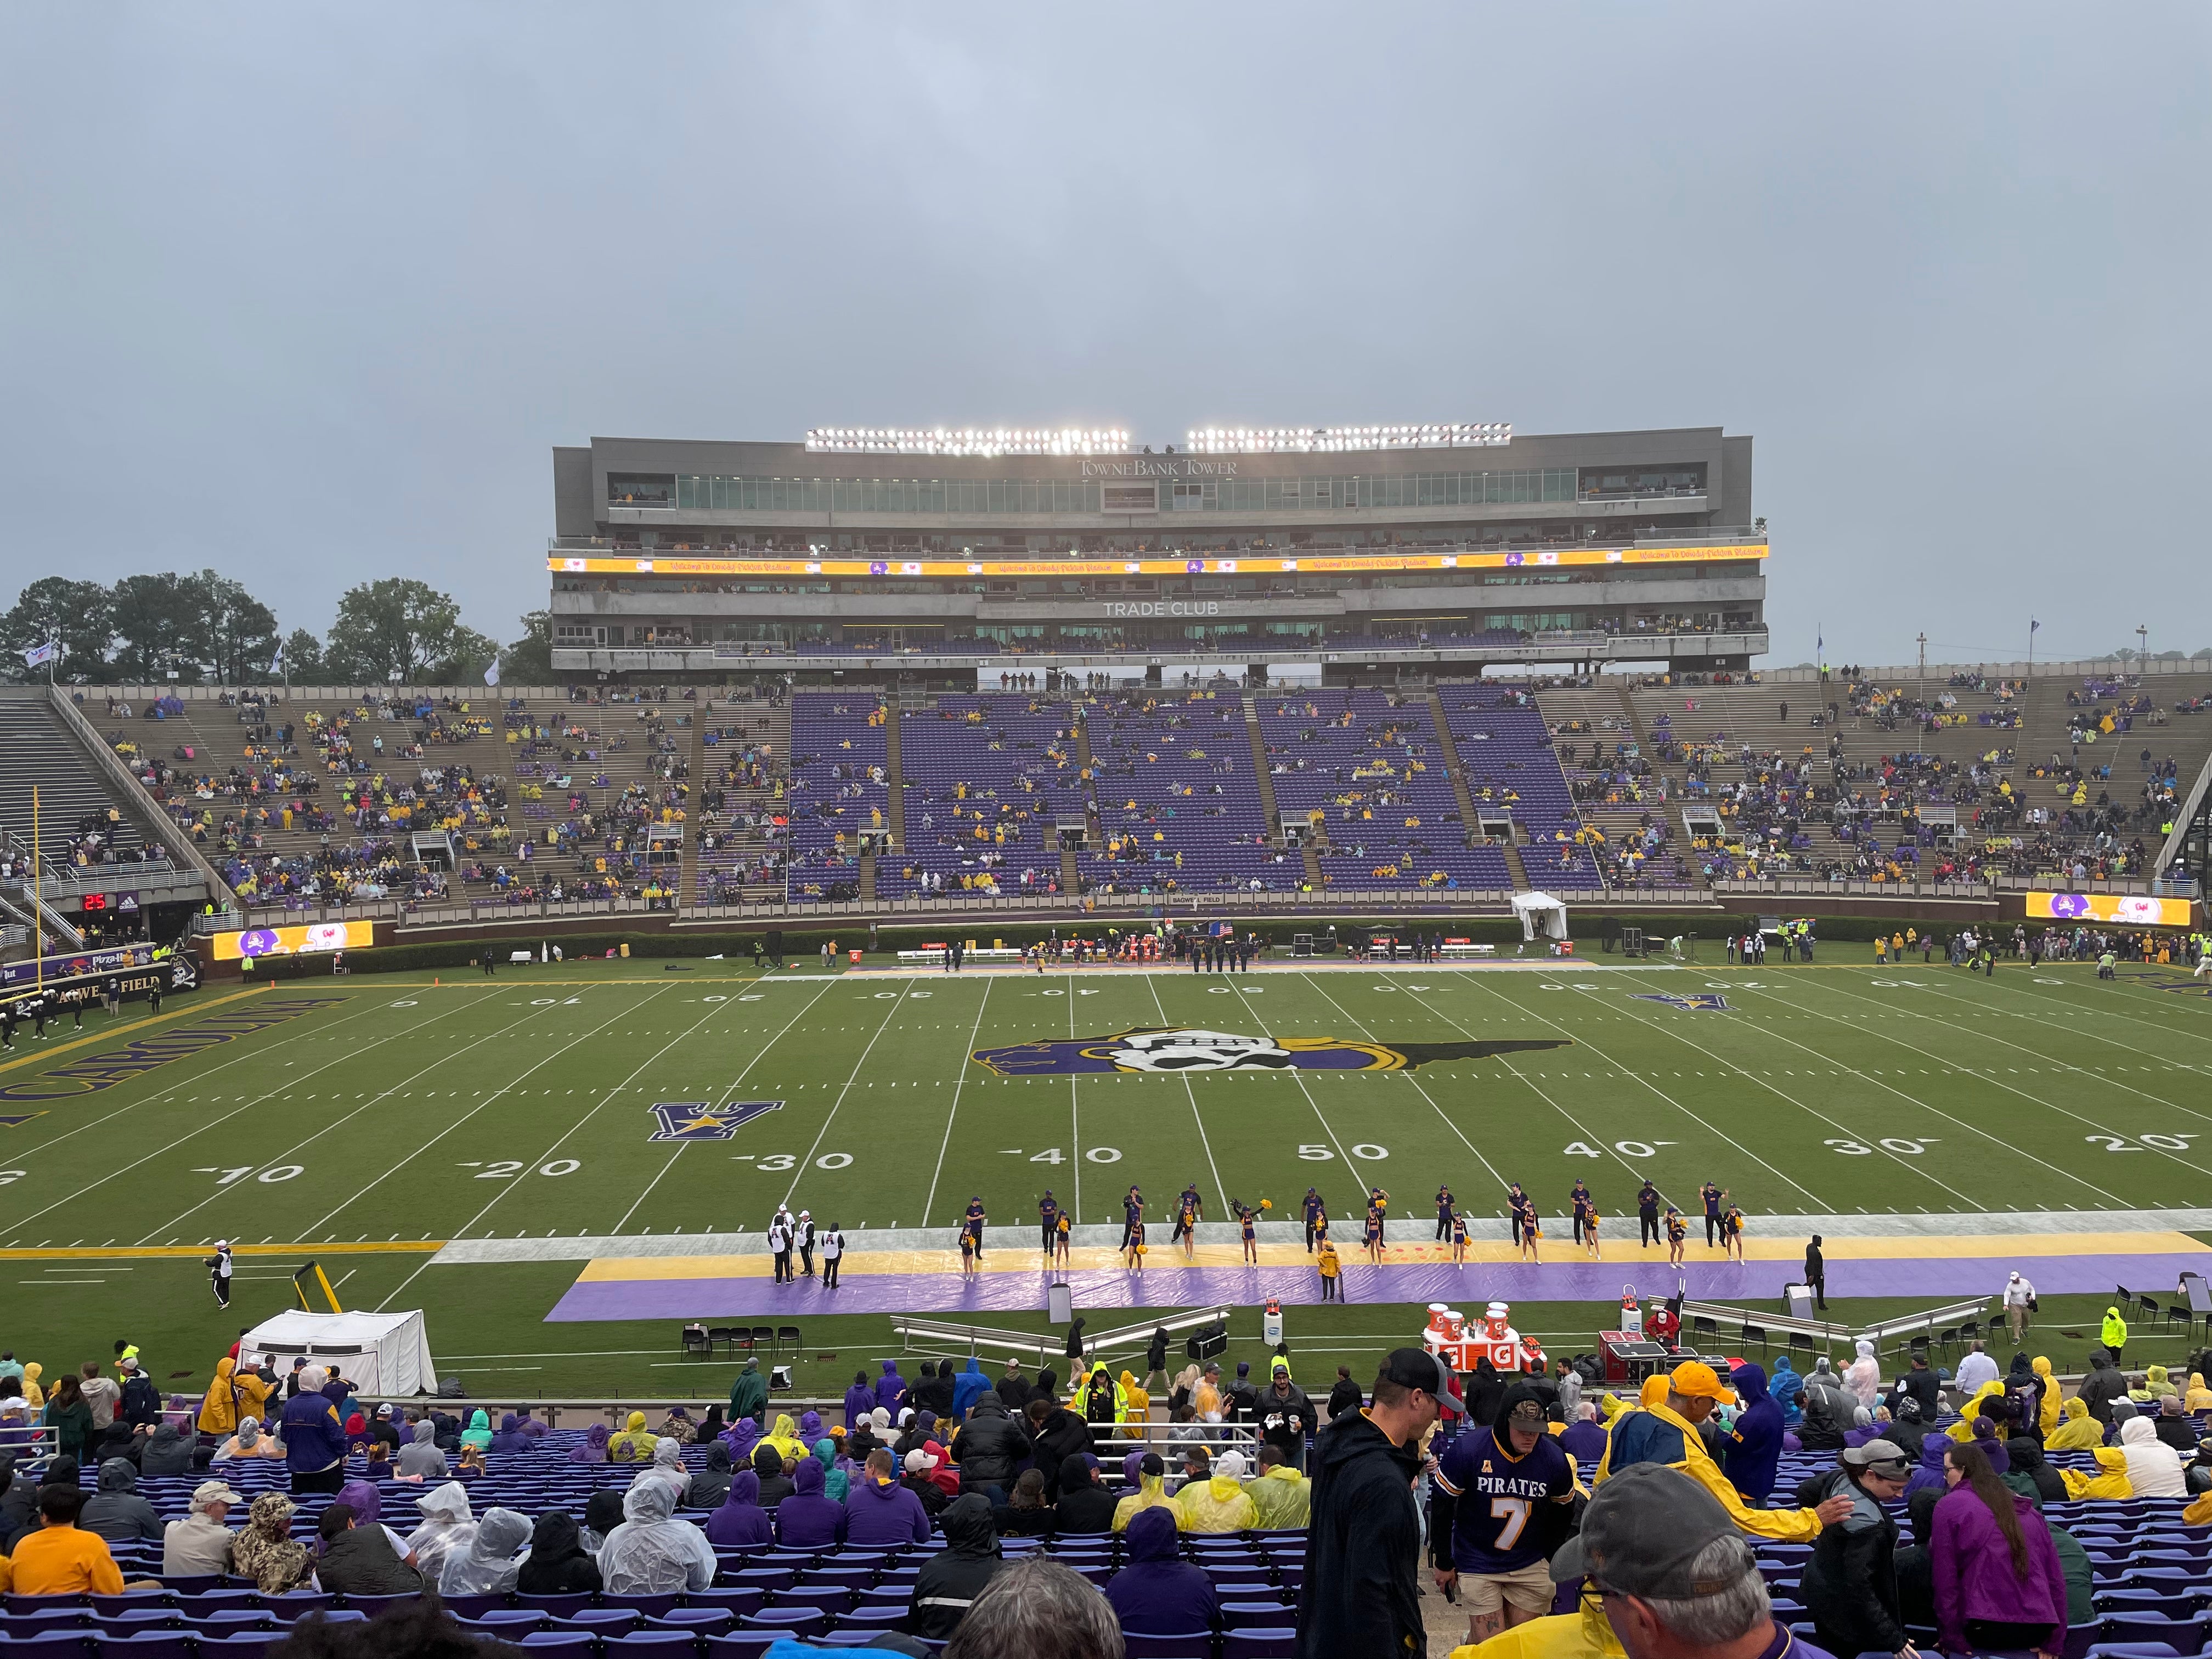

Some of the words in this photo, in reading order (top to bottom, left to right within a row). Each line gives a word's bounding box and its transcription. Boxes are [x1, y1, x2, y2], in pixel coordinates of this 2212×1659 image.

[1182, 459, 1238, 476] TOWER
[1103, 602, 1165, 616] TRADE
[1170, 601, 1219, 616] CLUB
[84, 894, 105, 910] 25
[1563, 1141, 1656, 1158] 40
[1824, 1138, 1925, 1155] 30
[2085, 1134, 2188, 1152] 20
[1029, 1147, 1123, 1164] 40
[1298, 1144, 1389, 1160] 50
[474, 1160, 581, 1178] 20
[757, 1153, 854, 1170] 30
[216, 1166, 304, 1184] 10
[1436, 1316, 1443, 1324] G
[1452, 1323, 1459, 1331] G
[1494, 1322, 1503, 1330] G
[1494, 1345, 1510, 1364] G
[1476, 1476, 1547, 1497] PIRATES
[1491, 1497, 1532, 1550] 7
